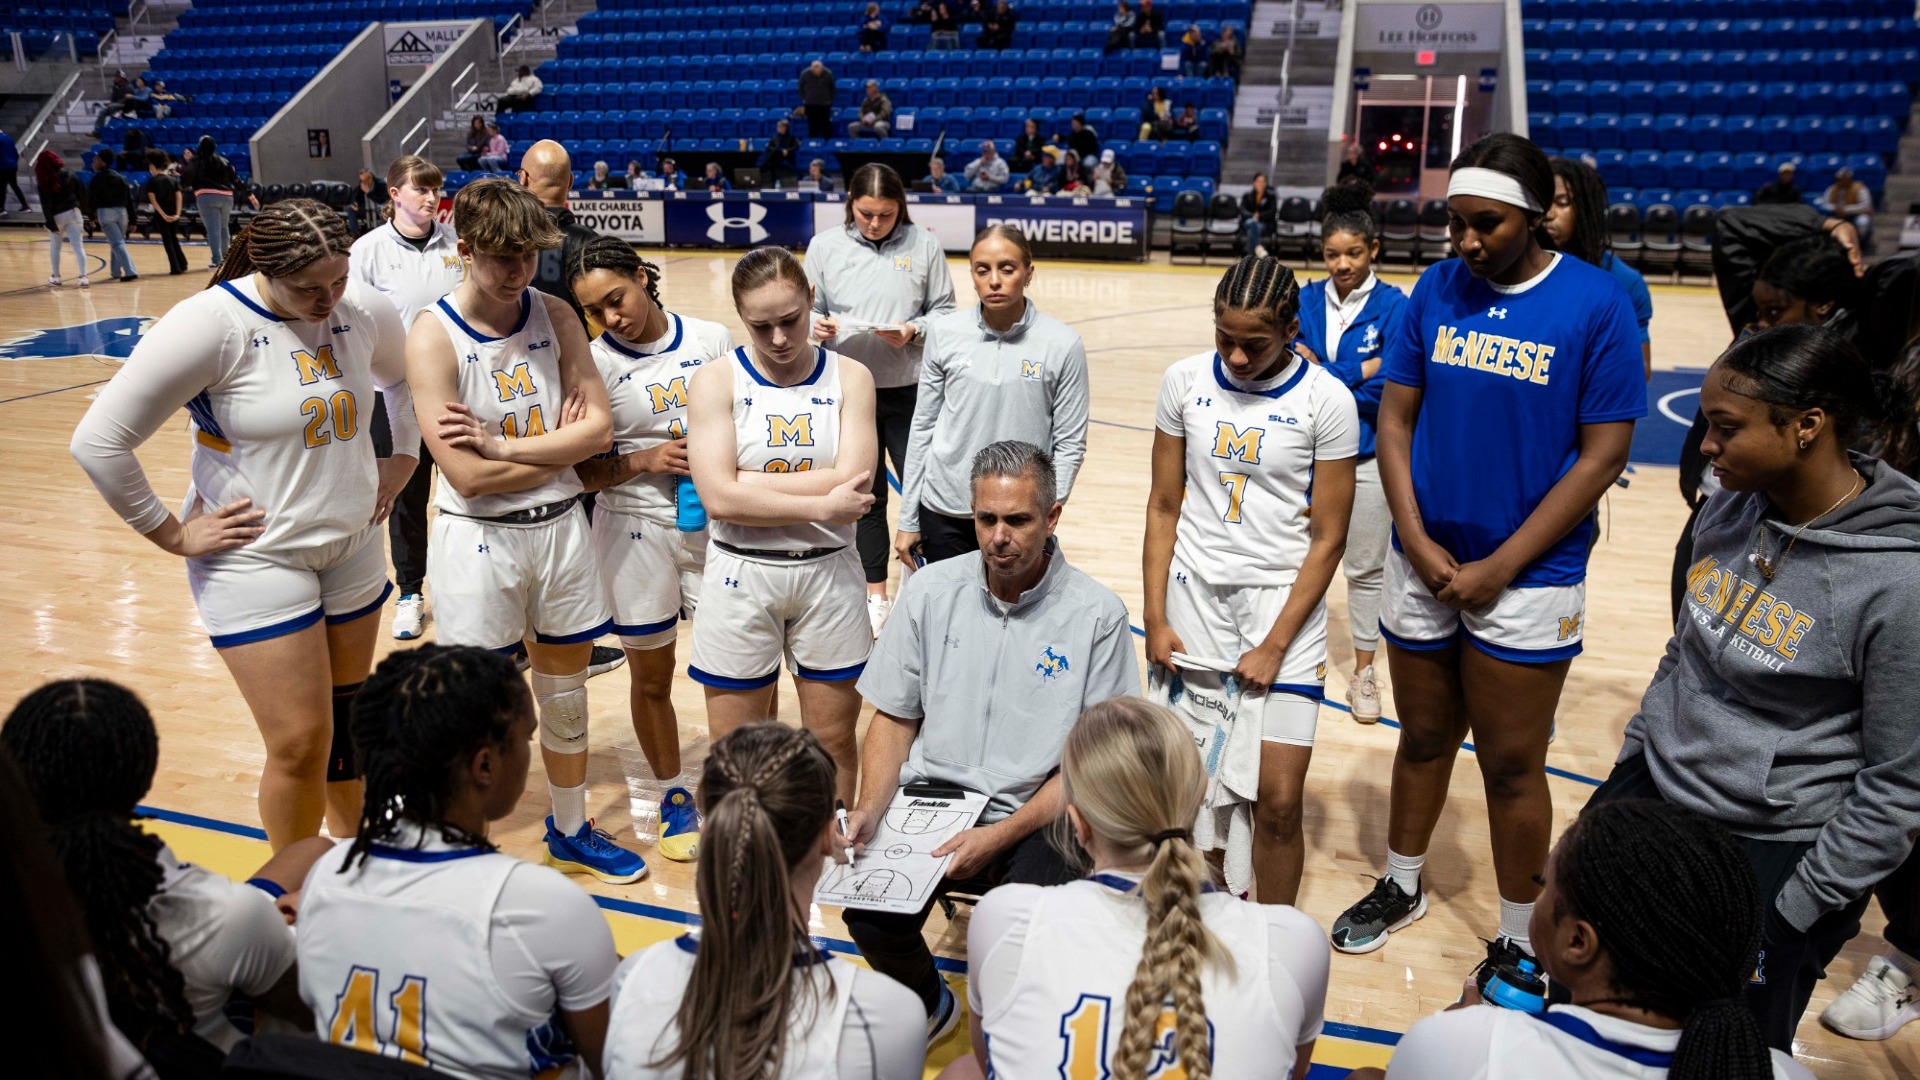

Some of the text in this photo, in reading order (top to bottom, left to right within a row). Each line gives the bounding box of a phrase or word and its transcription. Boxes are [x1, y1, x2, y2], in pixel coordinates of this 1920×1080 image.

[573, 202, 643, 211] LAKE CHARLES
[574, 214, 643, 231] TOYOTA
[893, 255, 912, 272] M
[291, 344, 343, 386] M
[680, 359, 702, 368] SLC
[1021, 359, 1043, 379] M
[491, 362, 537, 402] M
[646, 376, 687, 414] M
[811, 397, 834, 406] SLC
[300, 390, 358, 449] 20
[766, 413, 814, 447] M
[1268, 414, 1298, 425] SLC
[1211, 420, 1265, 465] M
[1219, 471, 1250, 524] 7
[1557, 611, 1581, 641] M
[328, 964, 433, 1068] 41
